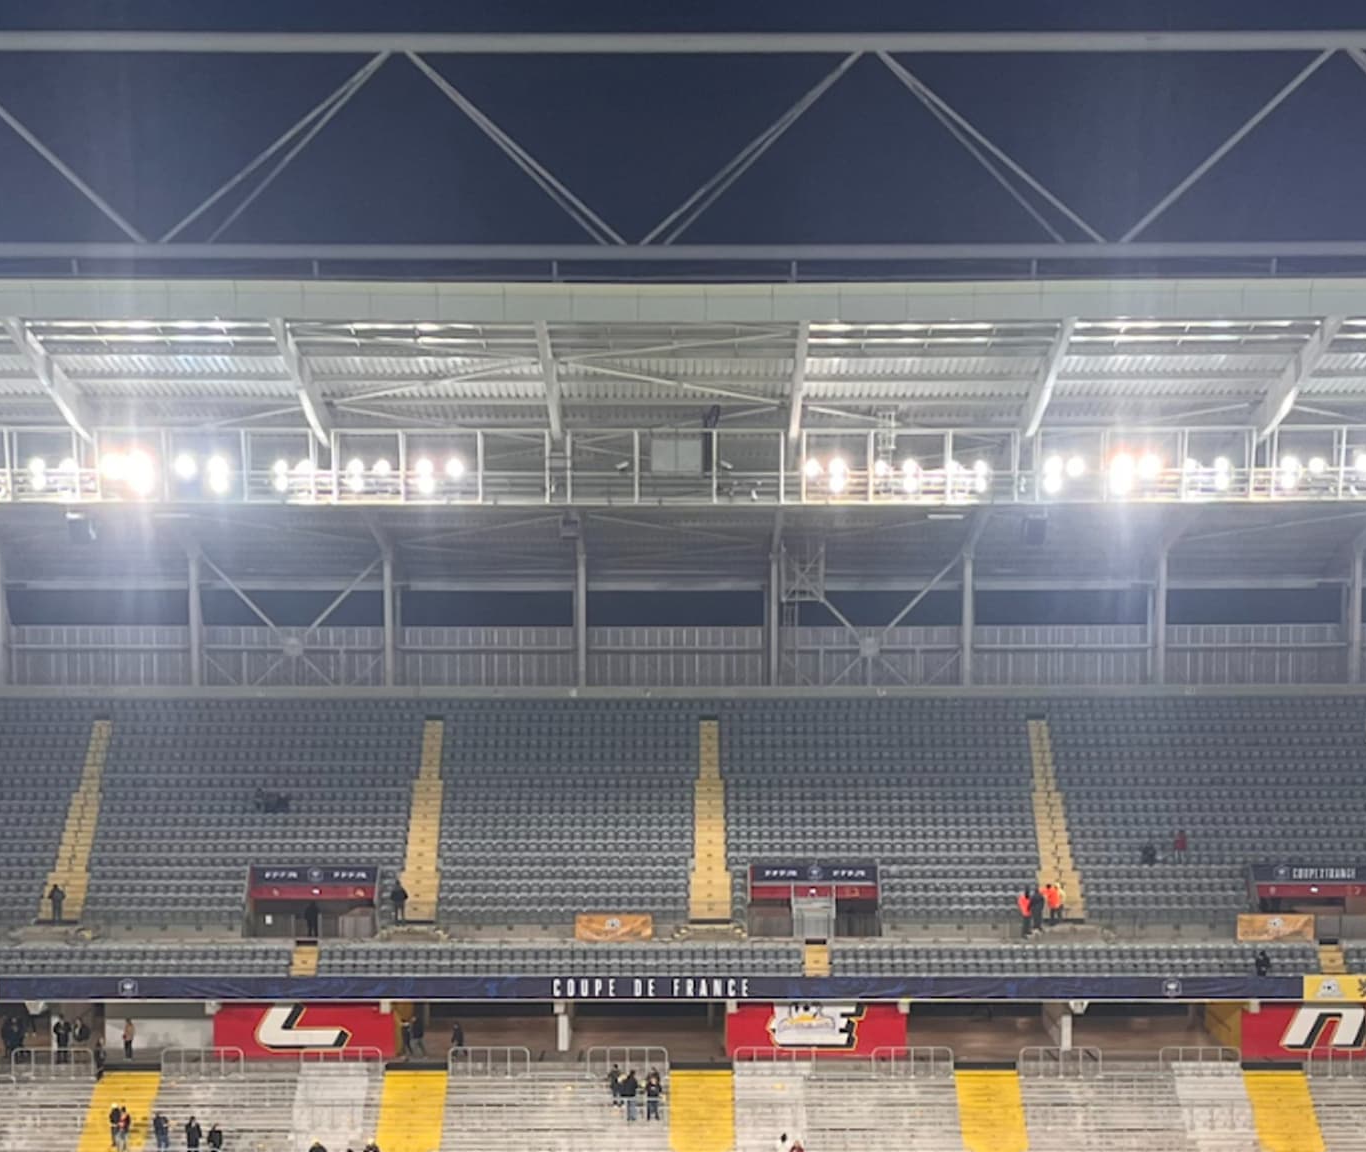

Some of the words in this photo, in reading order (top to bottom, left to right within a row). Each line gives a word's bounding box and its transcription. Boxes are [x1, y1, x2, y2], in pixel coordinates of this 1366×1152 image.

[553, 978, 618, 998] COUPE
[634, 978, 656, 998] DE
[673, 978, 749, 998] FRANCE
[257, 1003, 350, 1050] L
